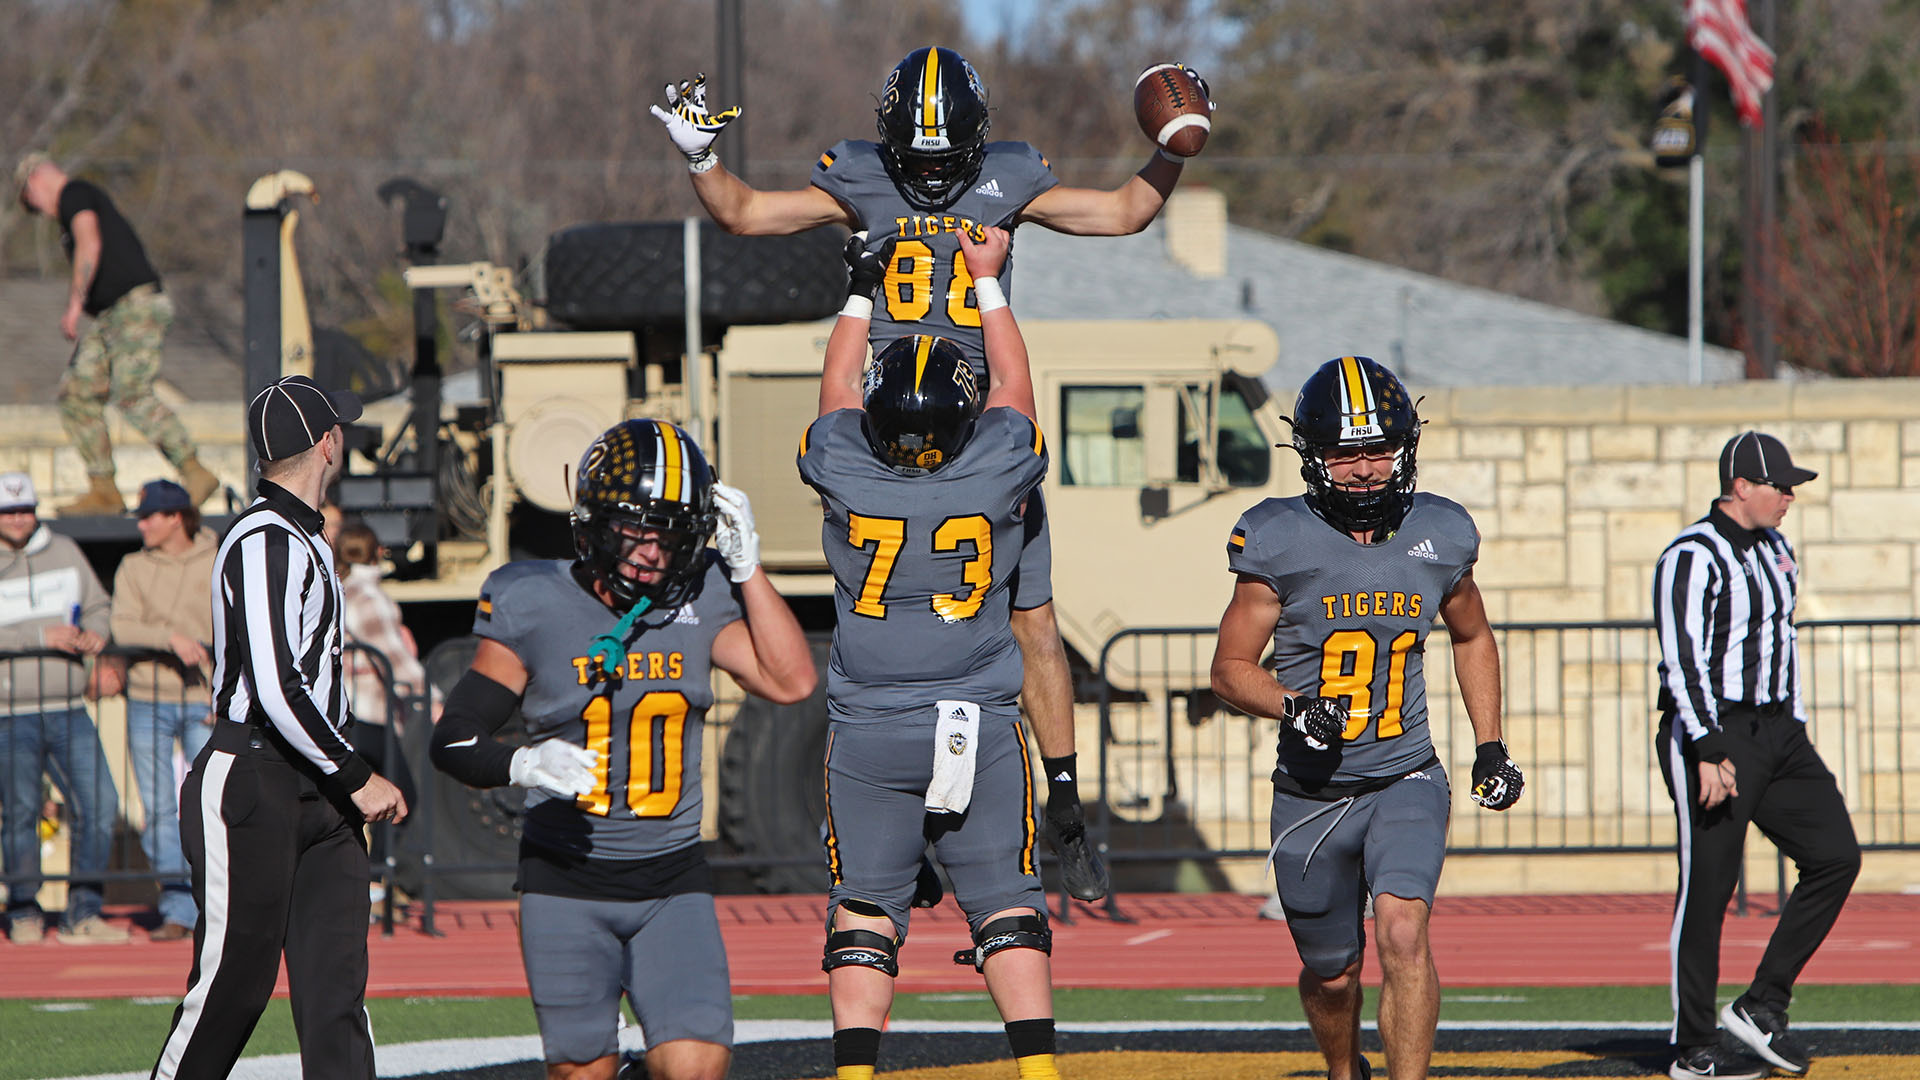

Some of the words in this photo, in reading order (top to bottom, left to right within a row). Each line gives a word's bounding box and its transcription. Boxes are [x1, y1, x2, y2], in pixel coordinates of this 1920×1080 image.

[975, 186, 1004, 198] adidas
[895, 215, 987, 243] TIGERS
[883, 239, 983, 327] 88
[1351, 426, 1373, 436] FHSU
[847, 510, 993, 623] 73
[1407, 550, 1439, 560] adidas
[1322, 591, 1423, 619] TIGERS
[1317, 628, 1420, 742] 81
[575, 690, 692, 818] 10
[842, 953, 879, 963] DONJOY
